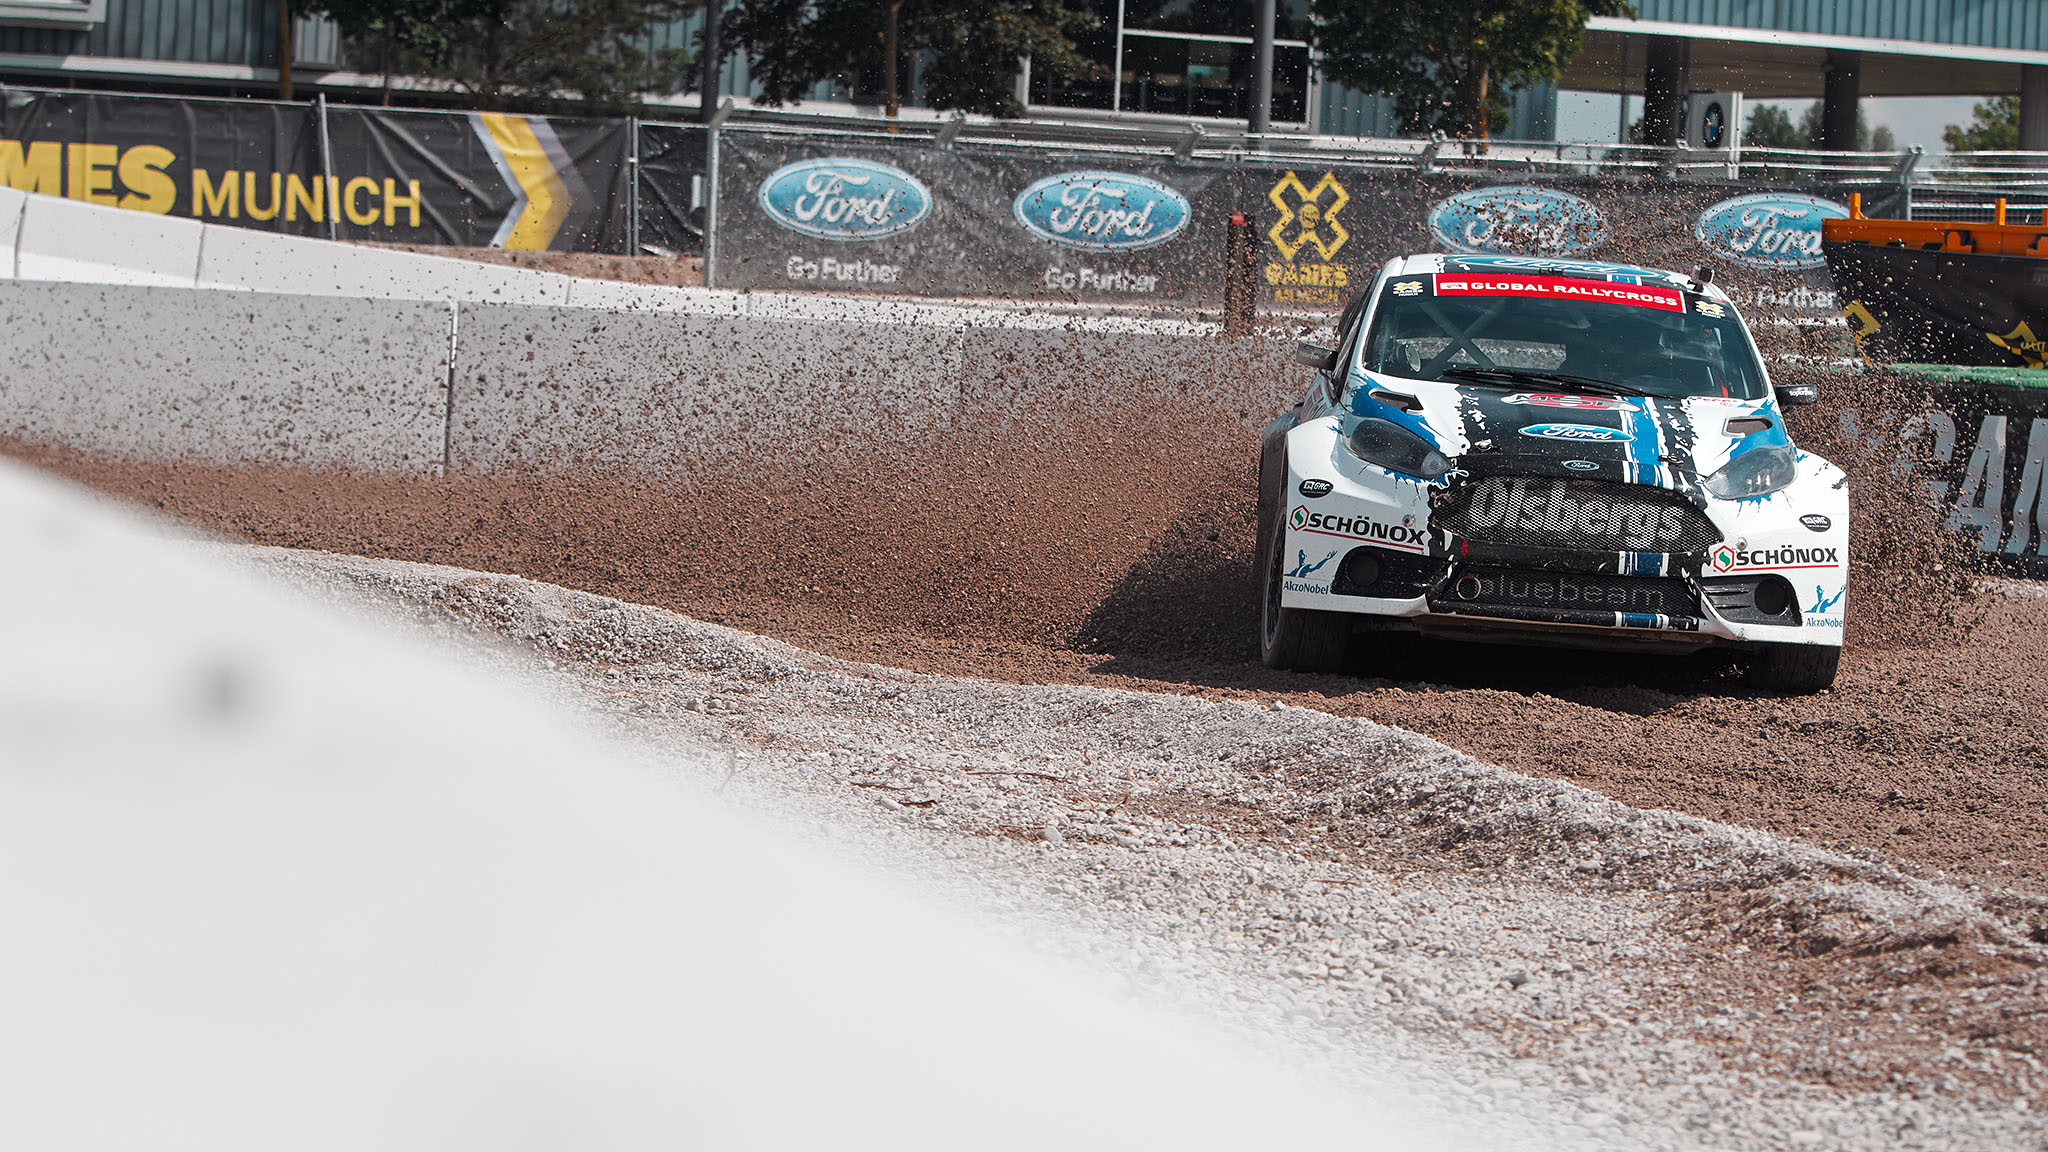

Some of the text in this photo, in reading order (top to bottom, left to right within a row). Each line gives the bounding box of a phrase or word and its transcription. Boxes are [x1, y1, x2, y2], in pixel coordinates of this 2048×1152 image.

[192, 168, 420, 228] MUNICH
[795, 170, 895, 225] Ford
[1050, 183, 1155, 237] Ford
[787, 256, 901, 283] Go Further
[1045, 266, 1158, 293] Go Further
[1471, 281, 1678, 307] GLOBAL RALLYCROSS
[1543, 425, 1613, 440] Ford
[1468, 477, 1685, 549] Olsbergs
[1308, 513, 1426, 546] SCHÖNOX
[1736, 545, 1838, 566] SCHÖNOX
[1283, 581, 1328, 595] AkzoNobel
[1806, 617, 1844, 628] AkzoNobe
